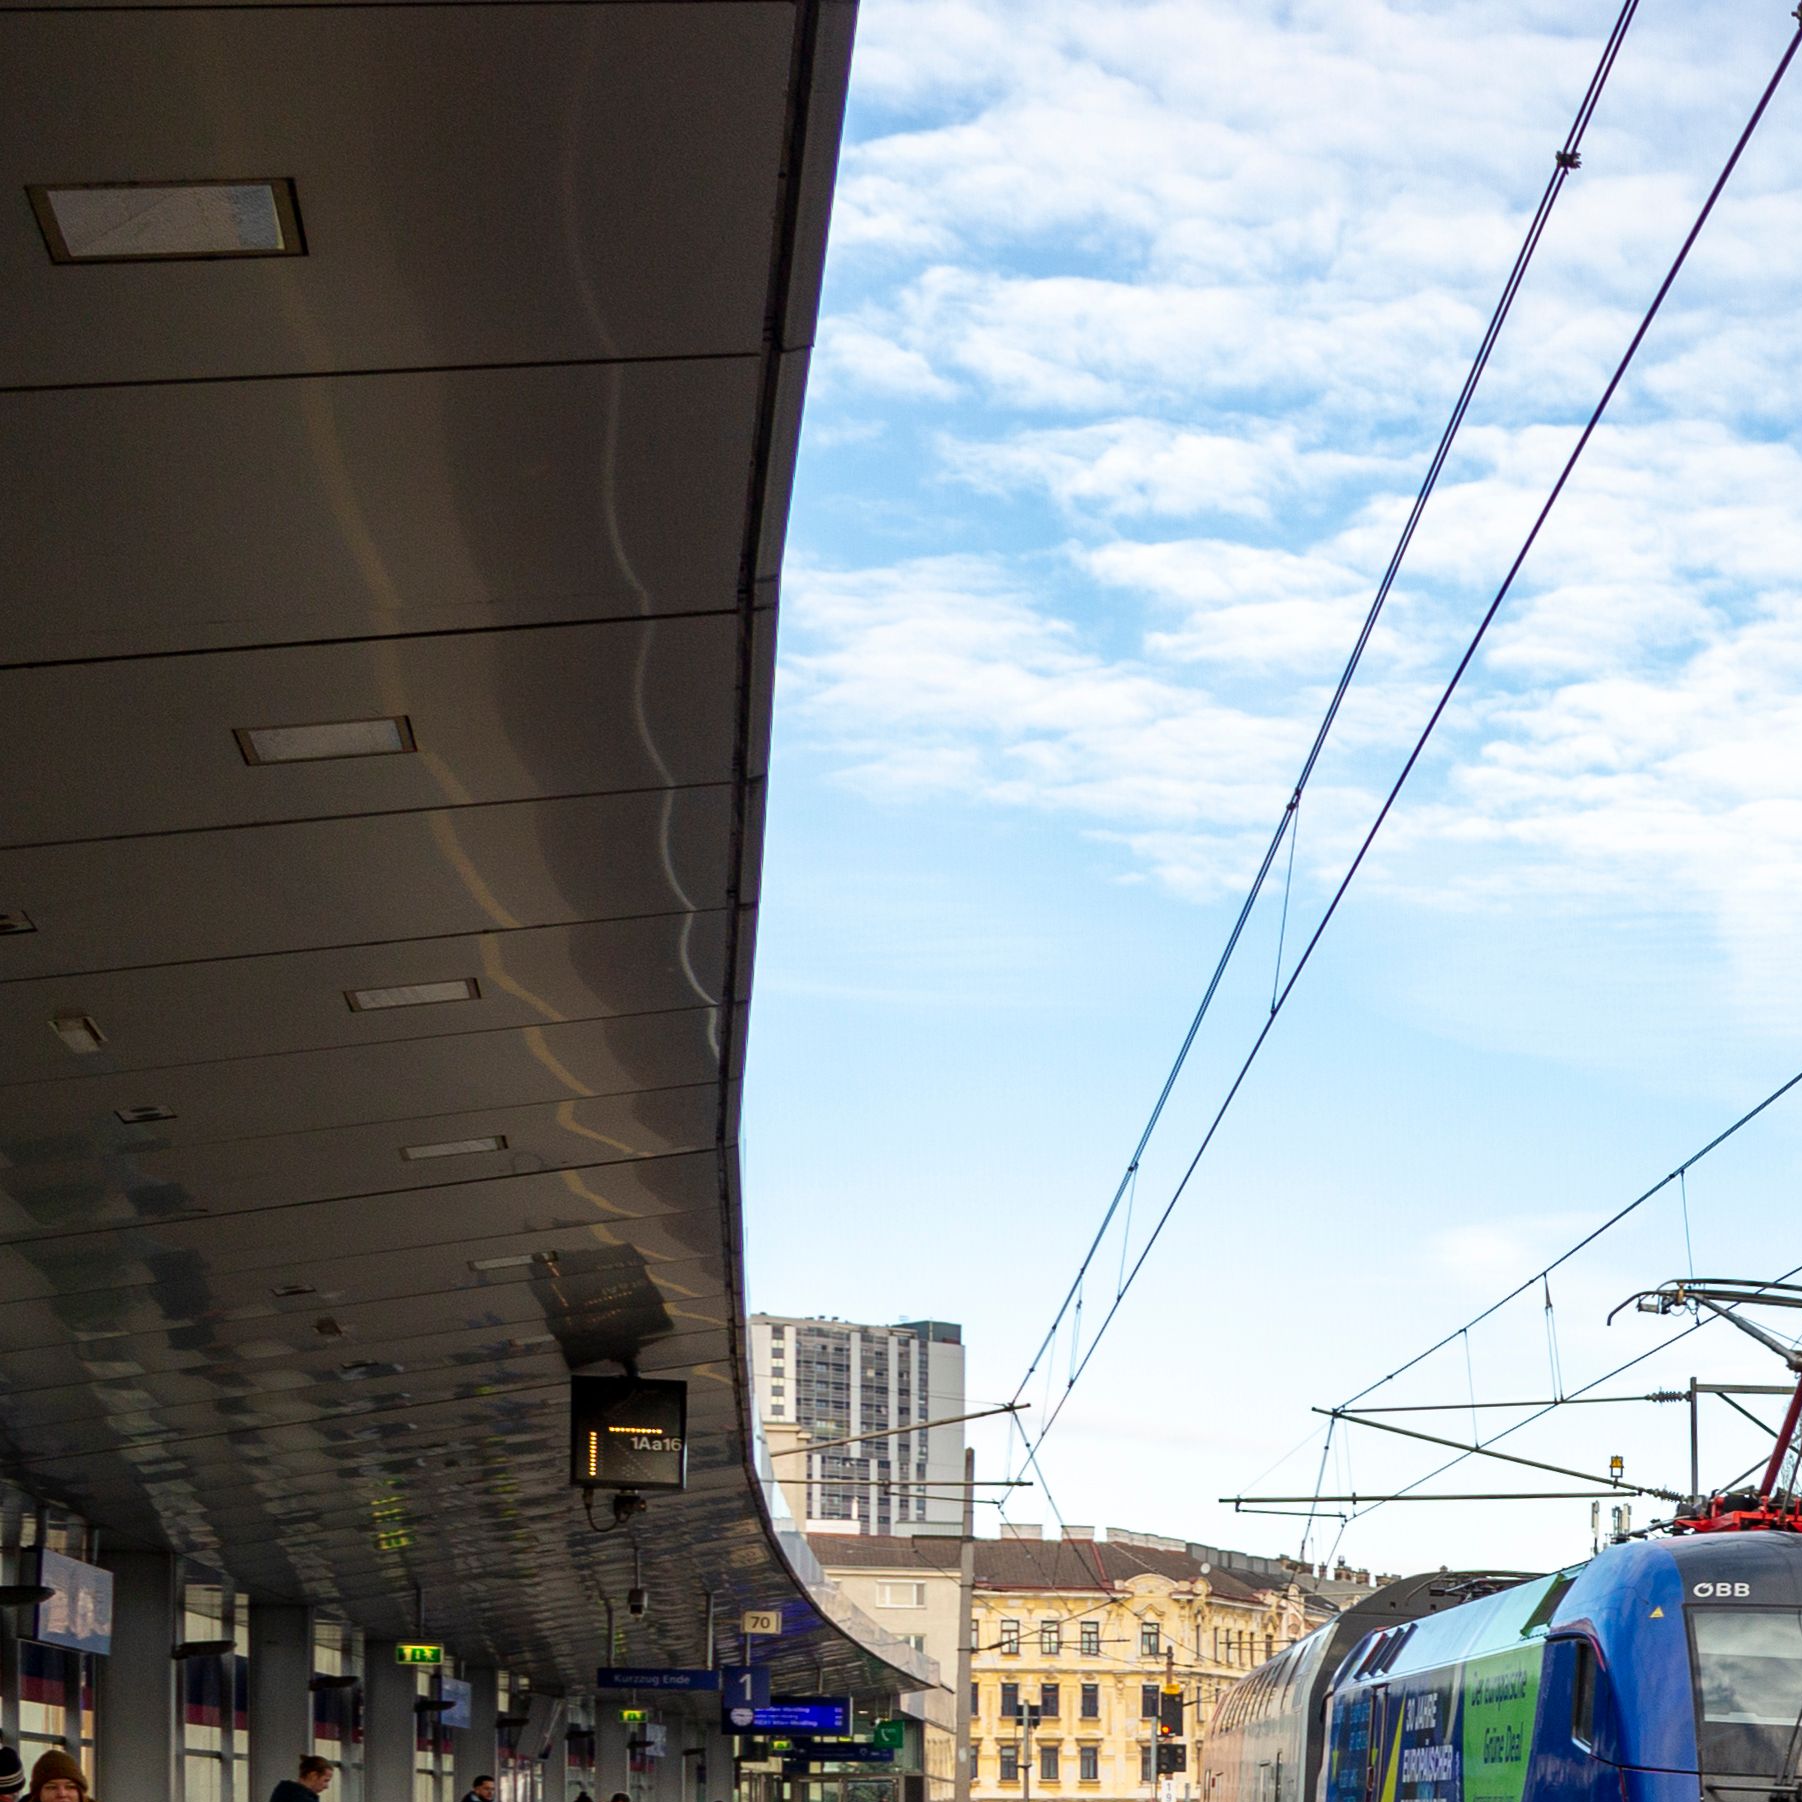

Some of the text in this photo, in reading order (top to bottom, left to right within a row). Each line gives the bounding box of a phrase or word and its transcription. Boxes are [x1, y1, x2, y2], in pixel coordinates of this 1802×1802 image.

[630, 1436, 682, 1452] 1Aa16
[750, 1615, 771, 1630] 70
[613, 1674, 691, 1685] Kurzzug Ende
[738, 1673, 752, 1701] 1
